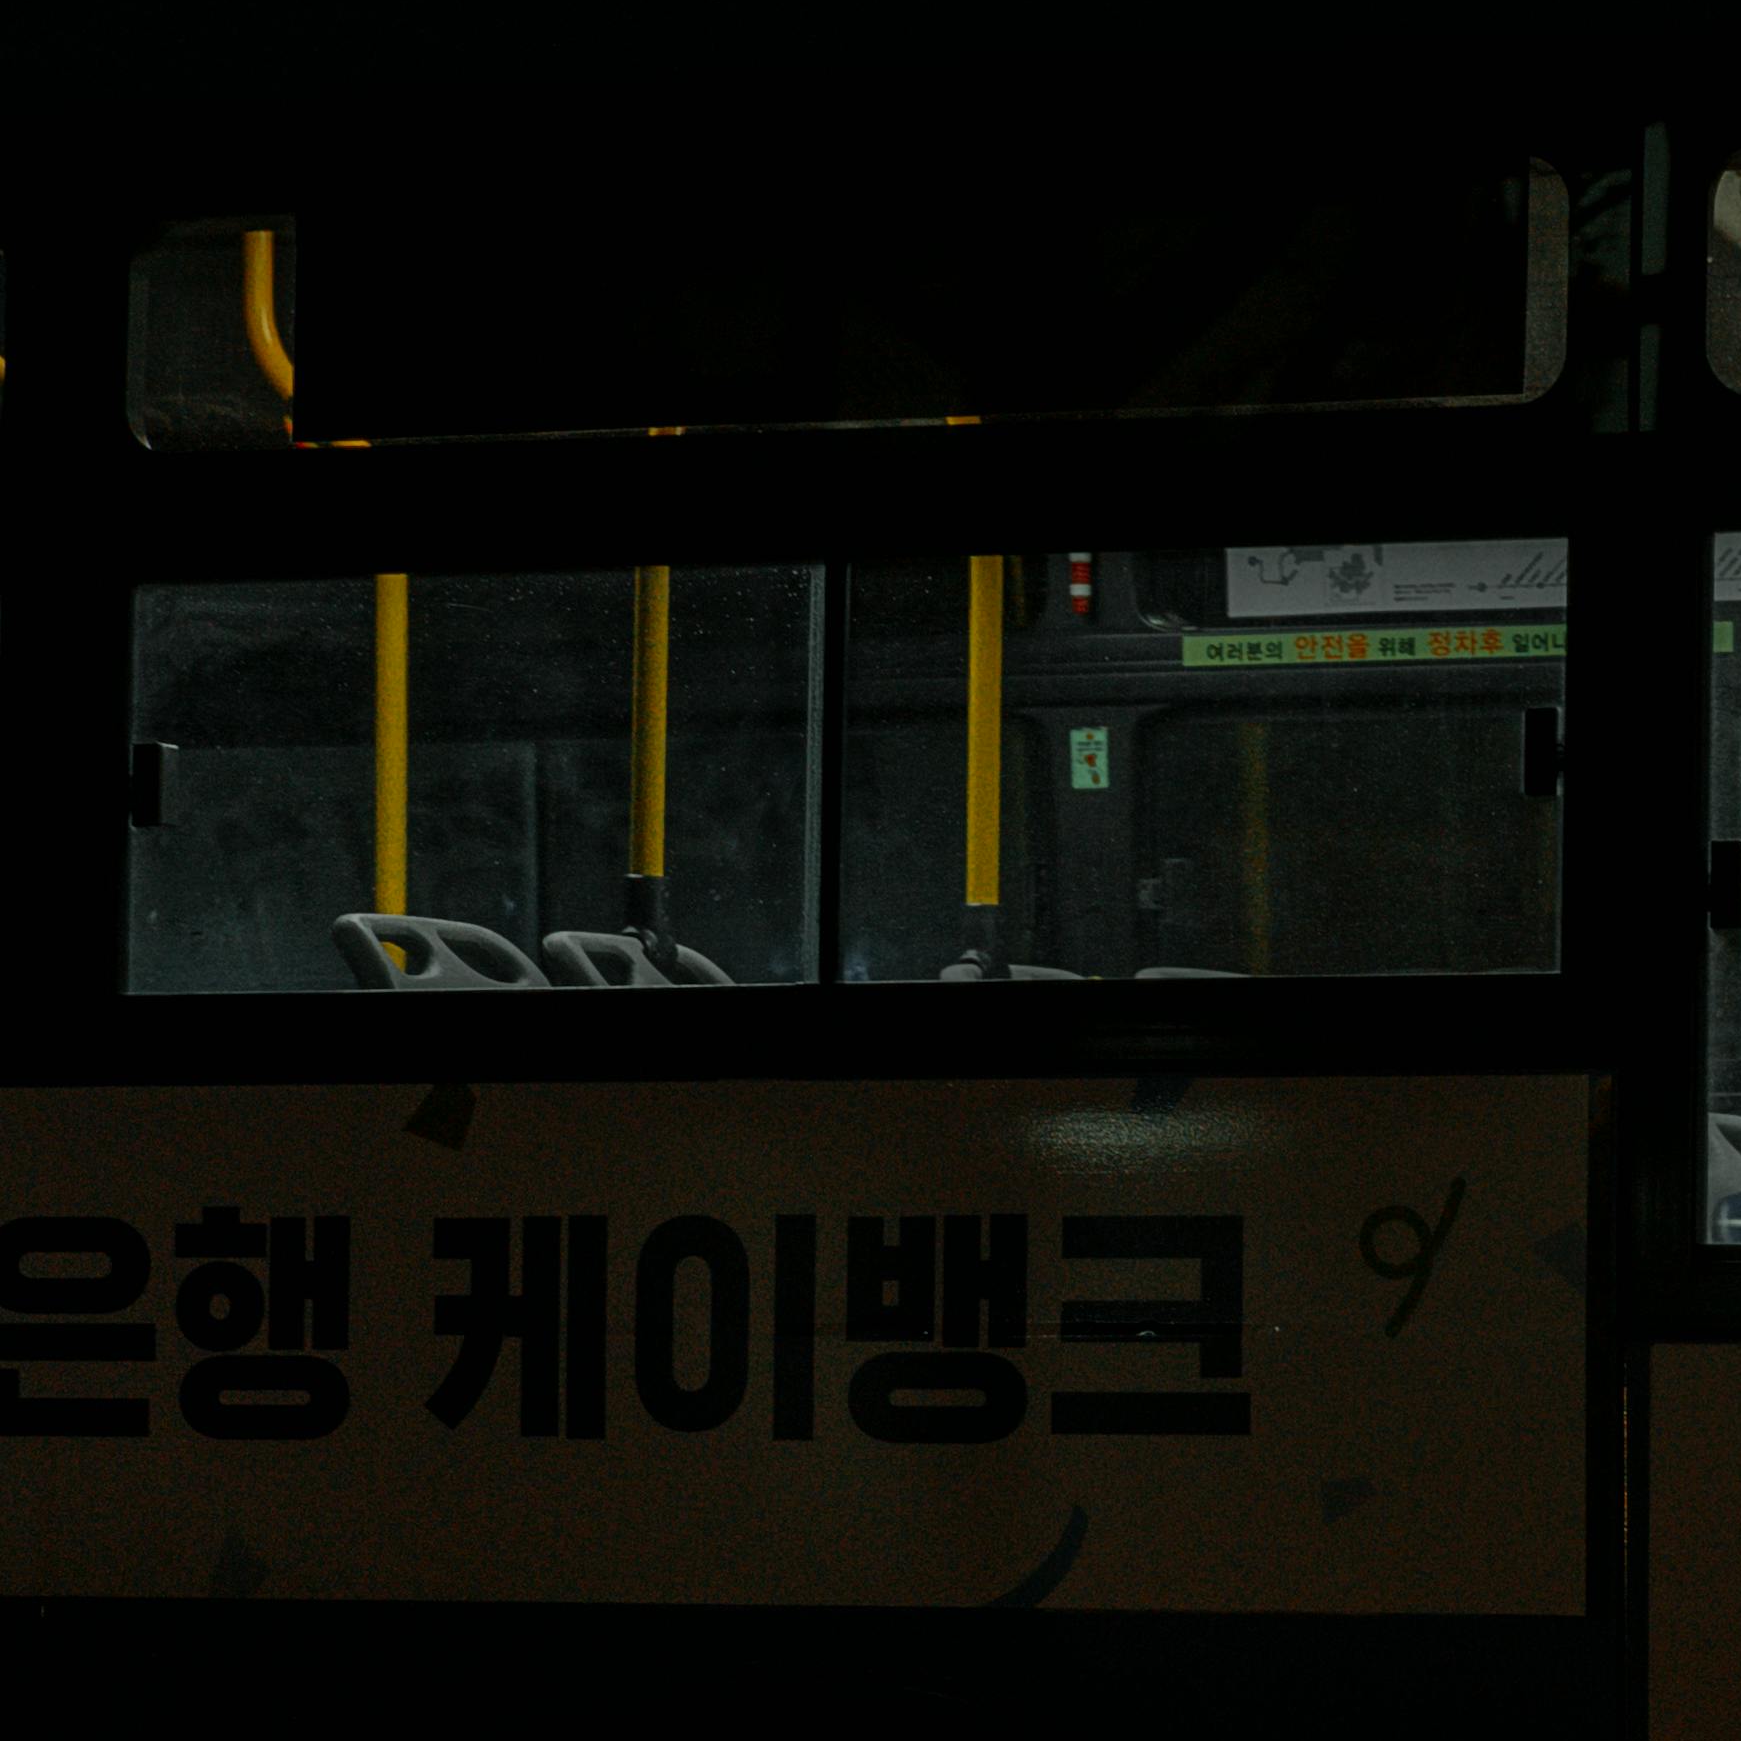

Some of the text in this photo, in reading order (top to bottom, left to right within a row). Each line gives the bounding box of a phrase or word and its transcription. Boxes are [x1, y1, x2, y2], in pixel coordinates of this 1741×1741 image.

[1205, 640, 1283, 661] 여러분의
[1294, 633, 1369, 660] 안전을
[1378, 636, 1416, 657] 위해
[1426, 628, 1503, 656] 정차후
[0, 1206, 1252, 1445] 은행 케이뱅크
